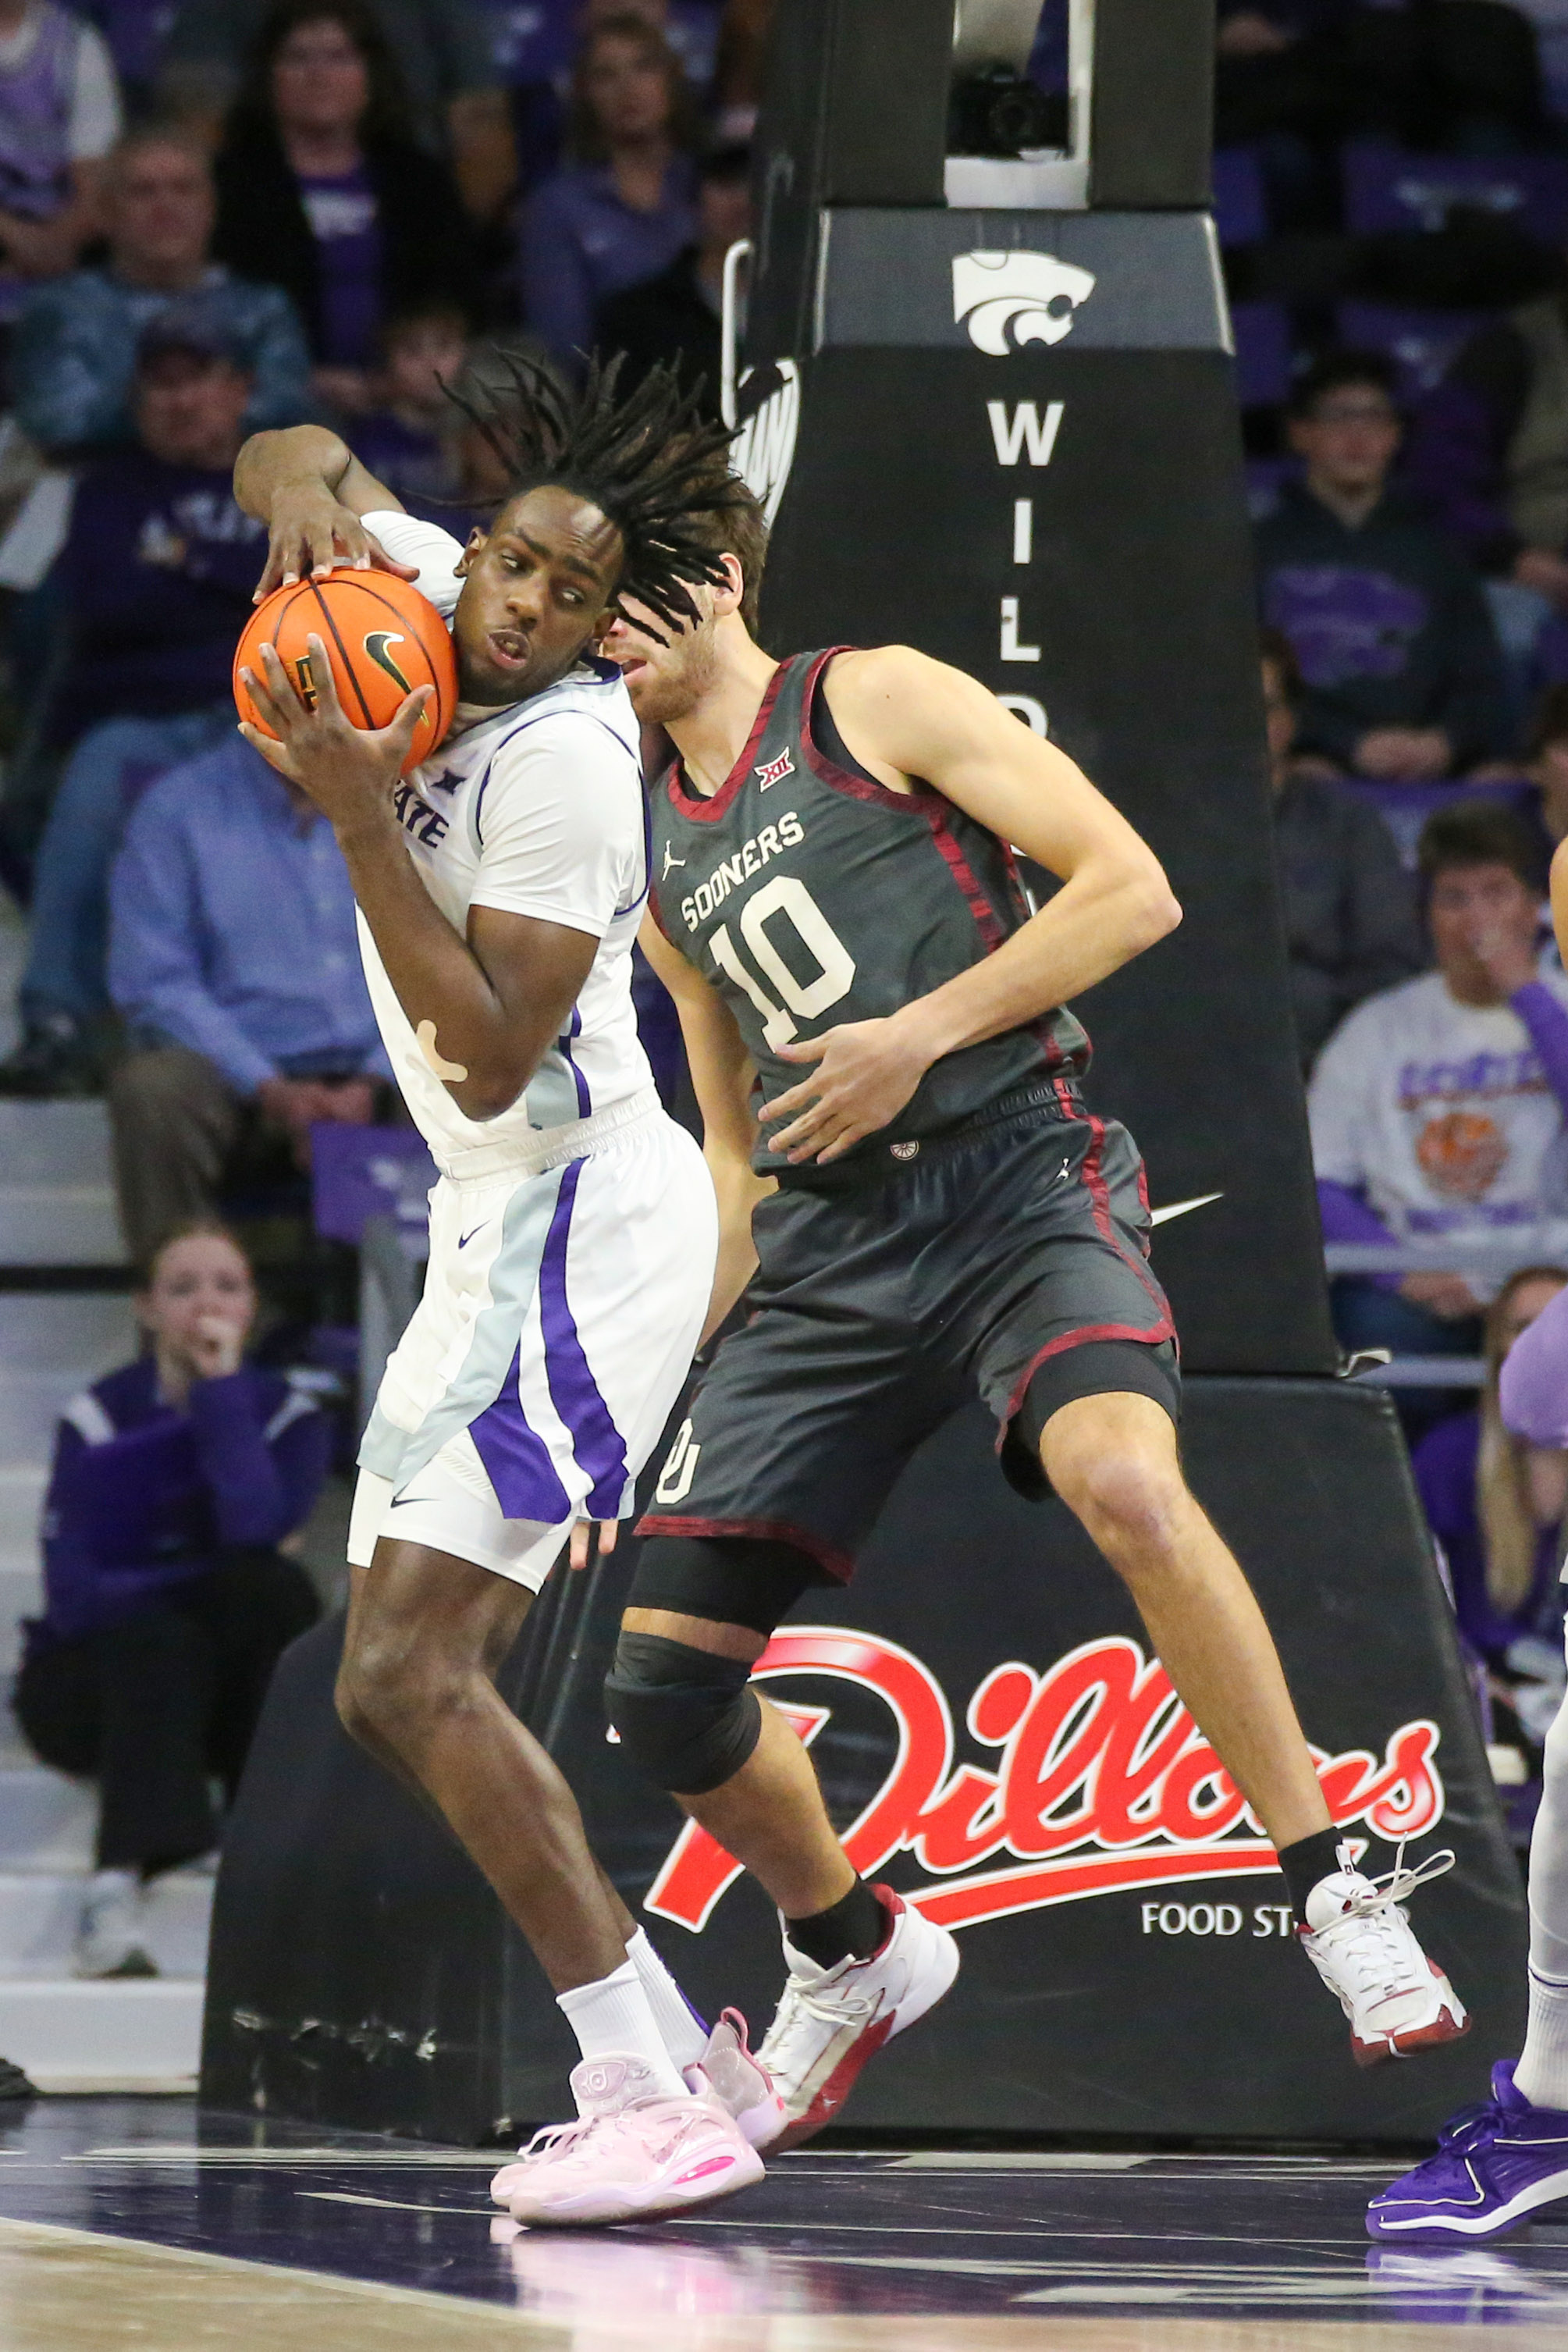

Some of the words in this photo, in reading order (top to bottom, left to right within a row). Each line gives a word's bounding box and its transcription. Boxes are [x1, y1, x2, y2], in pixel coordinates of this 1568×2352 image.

[393, 778, 450, 849] ATE
[681, 810, 805, 933] SOONERS
[708, 875, 856, 1054] 10
[1141, 1902, 1243, 1936] FOOD
